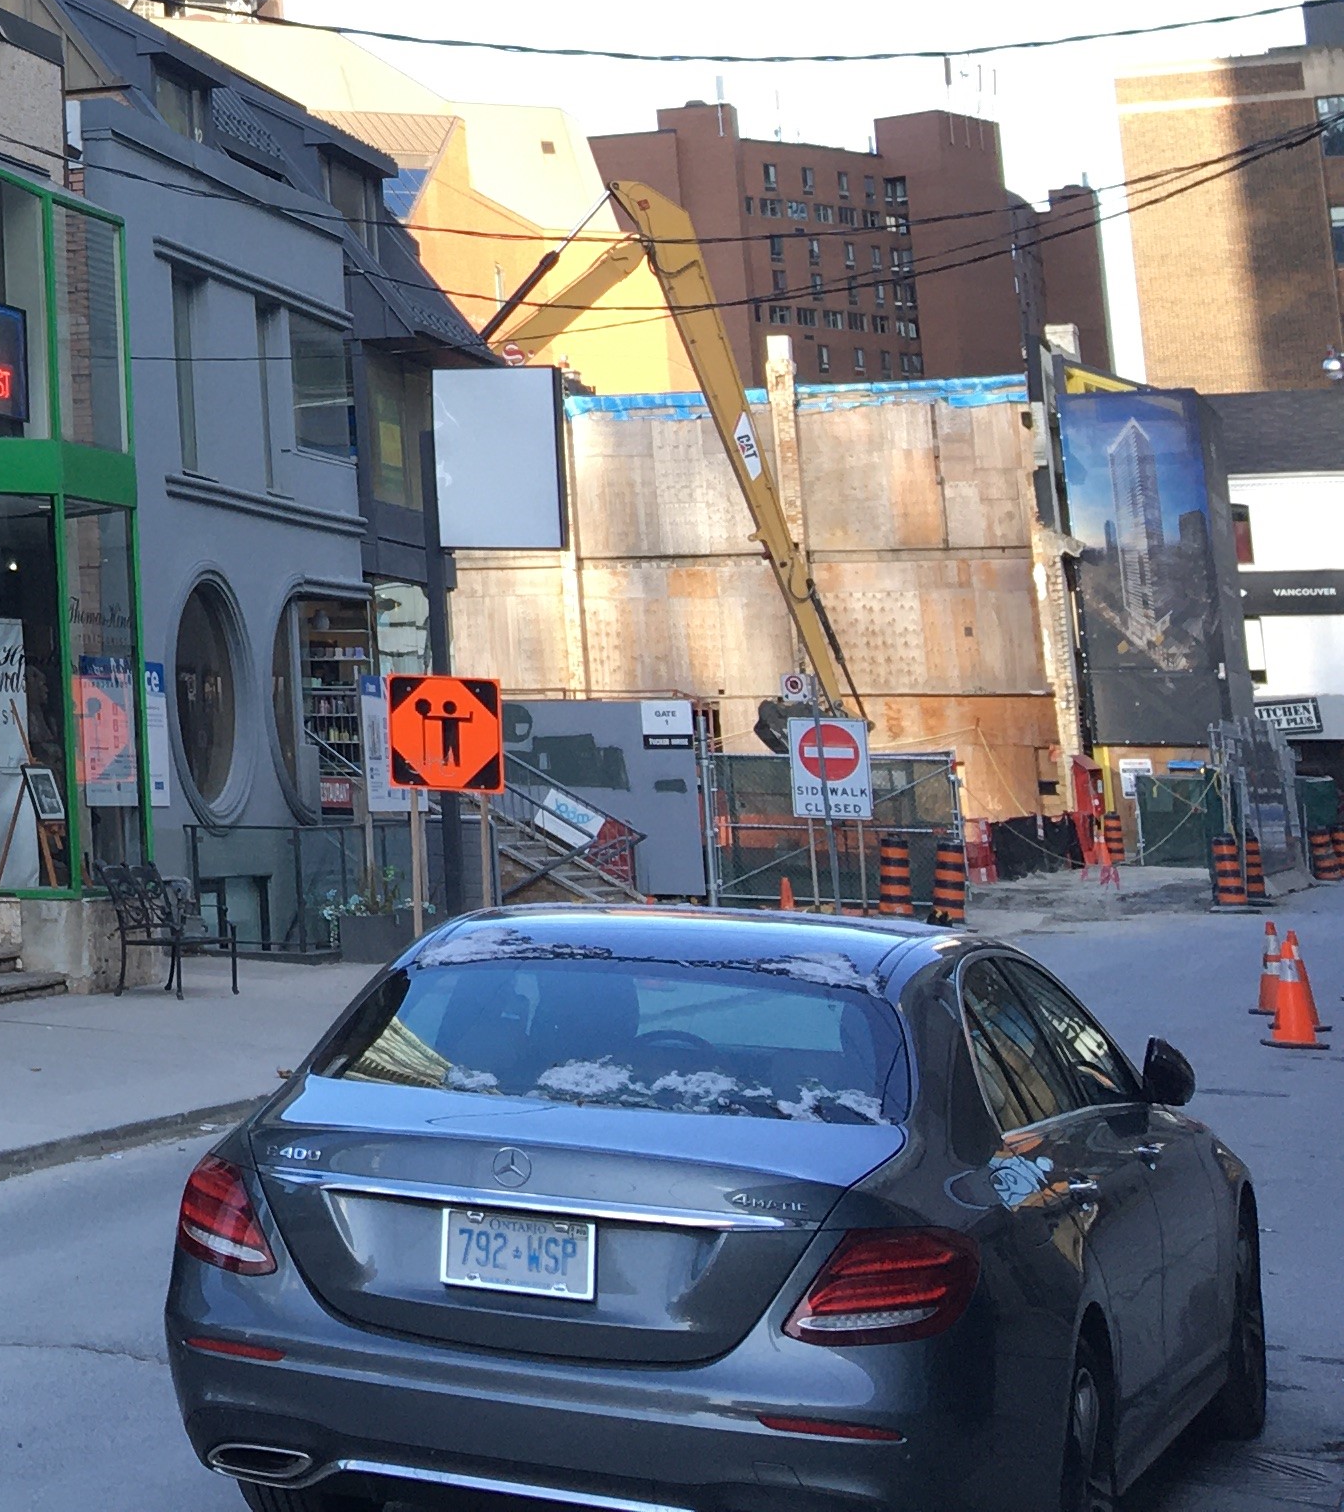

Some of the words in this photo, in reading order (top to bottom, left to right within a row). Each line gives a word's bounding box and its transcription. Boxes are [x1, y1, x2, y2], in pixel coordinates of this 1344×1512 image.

[737, 434, 758, 459] CAT
[1273, 587, 1337, 597] VANCOUVER
[654, 710, 677, 718] GATE
[1257, 705, 1312, 720] ITCHEN
[1286, 715, 1315, 727] PLUS
[797, 785, 868, 798] SIDWALK
[805, 802, 862, 814] CLSED
[490, 1217, 548, 1235] ONTARIO
[459, 1228, 509, 1270] 792
